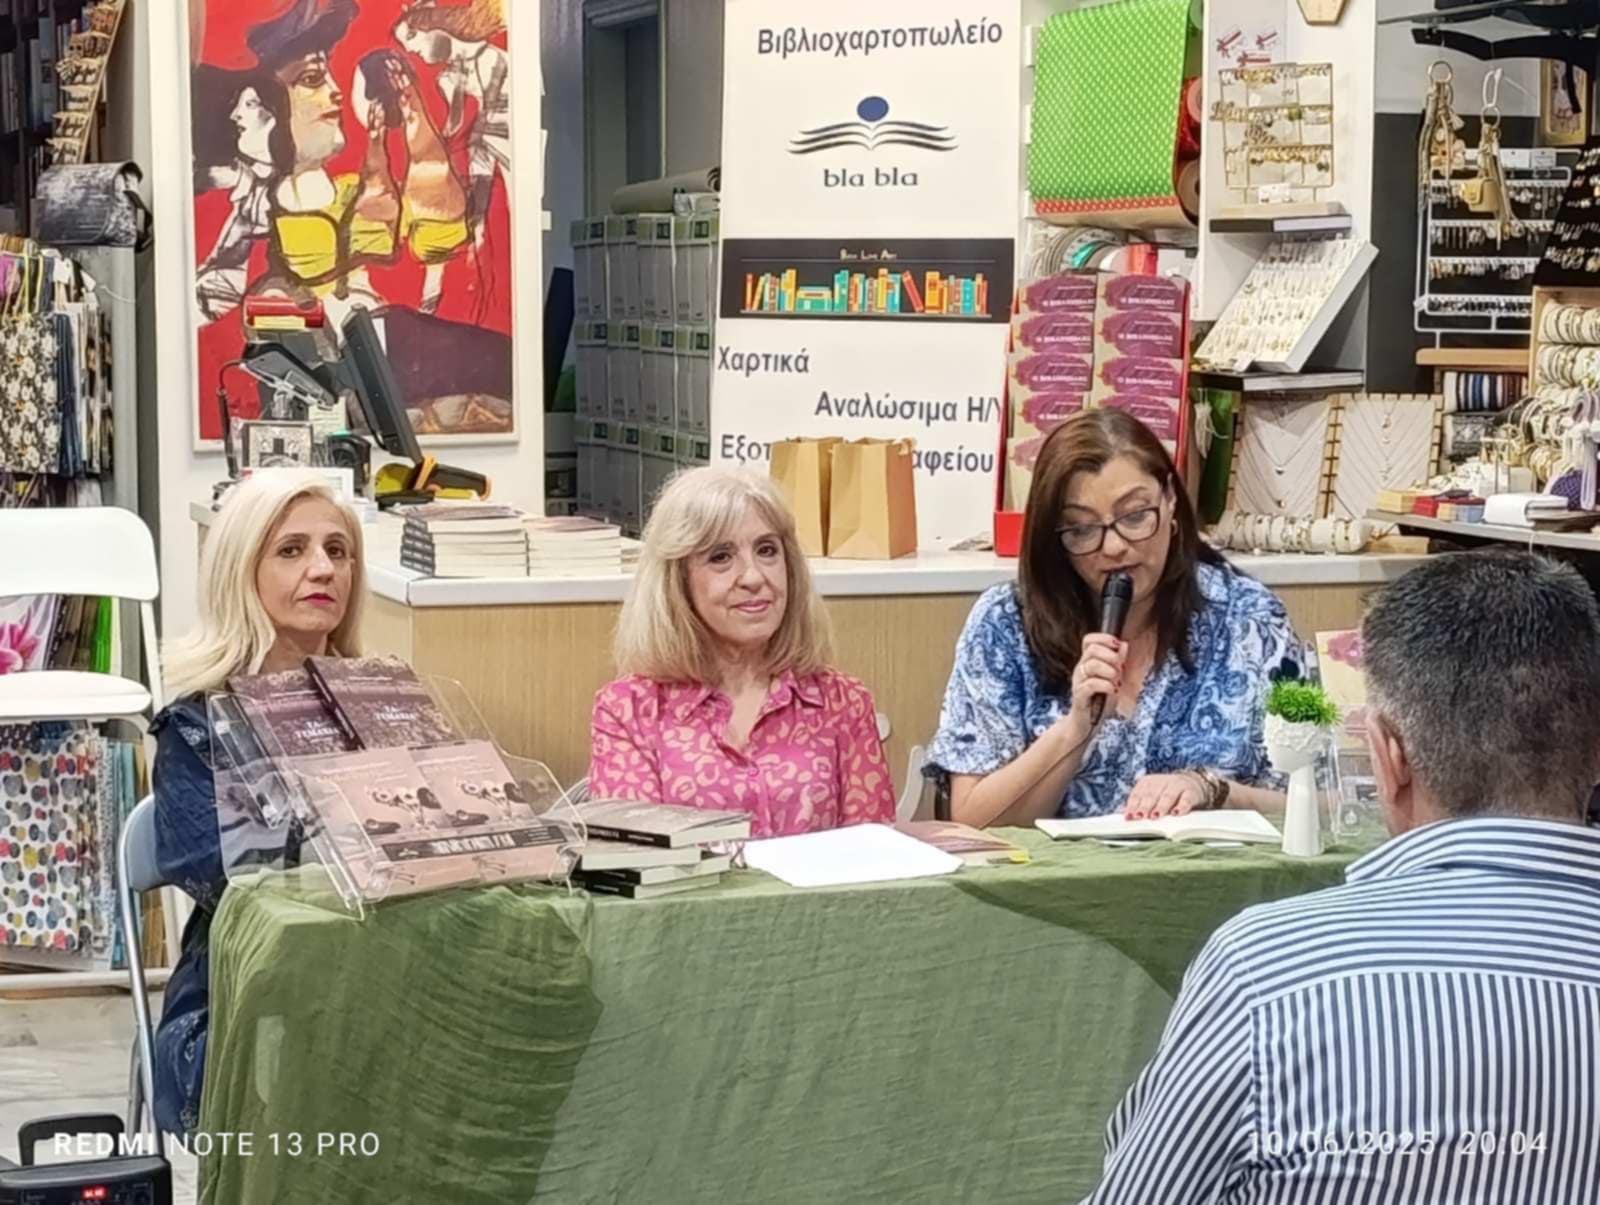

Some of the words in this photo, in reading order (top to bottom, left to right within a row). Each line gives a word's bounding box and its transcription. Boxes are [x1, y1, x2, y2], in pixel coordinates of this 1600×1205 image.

[758, 18, 1003, 59] Βιβλιοχαρτοπωλείο
[823, 168, 865, 188] bla
[874, 167, 919, 187] bla
[717, 346, 810, 377] Χαρτικά
[814, 391, 958, 427] Αναλώσιμα
[911, 445, 994, 477] αφείου
